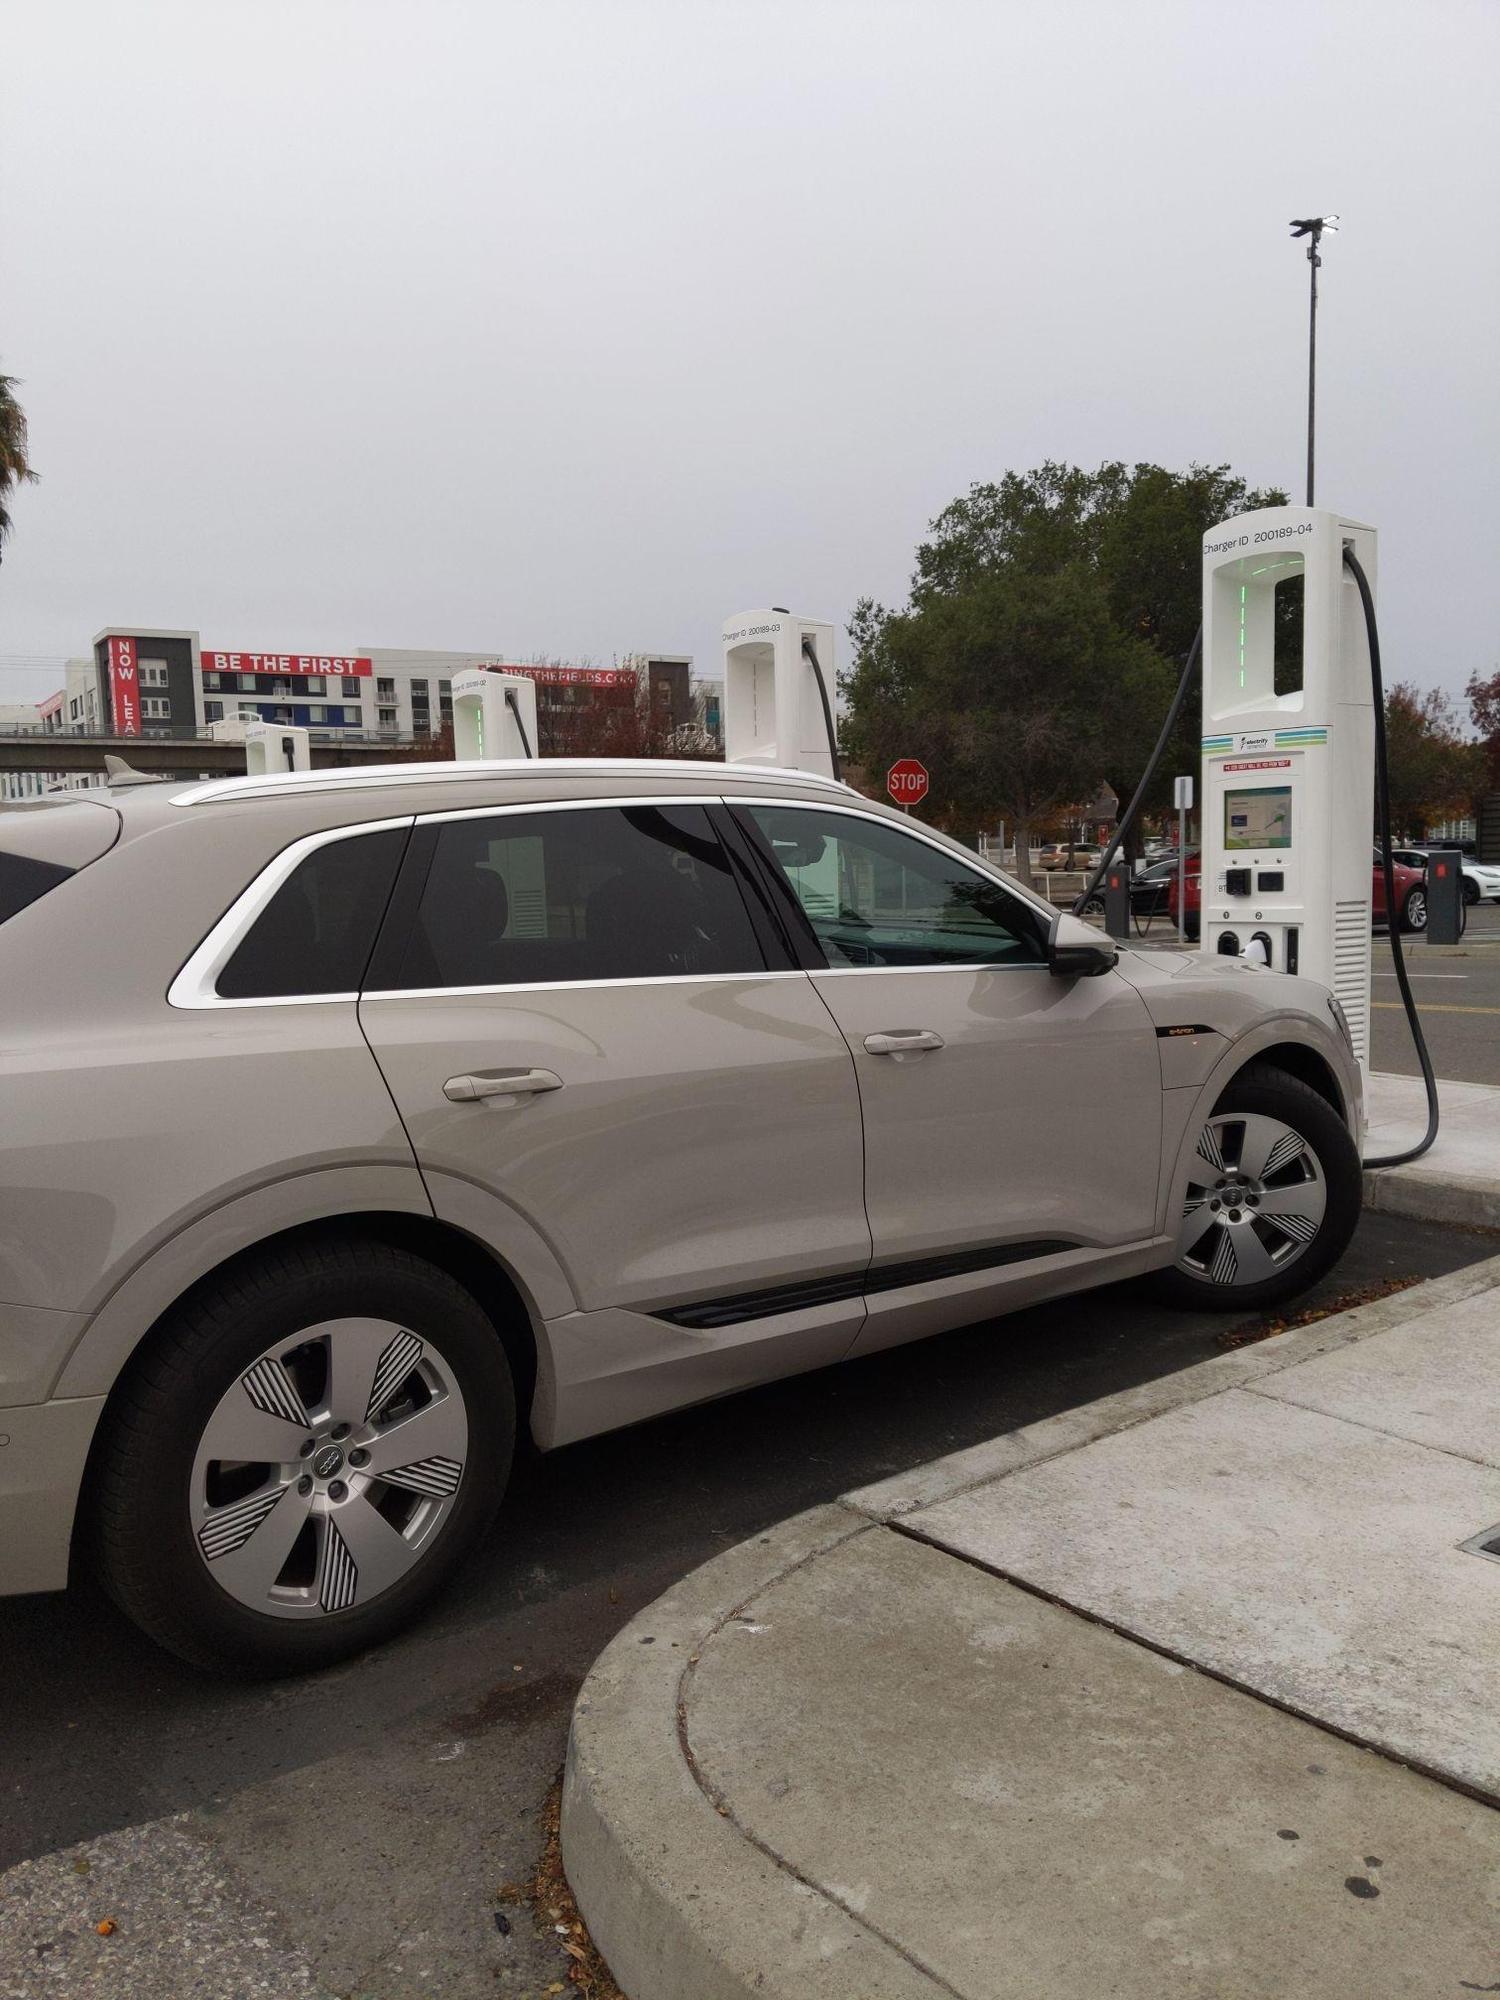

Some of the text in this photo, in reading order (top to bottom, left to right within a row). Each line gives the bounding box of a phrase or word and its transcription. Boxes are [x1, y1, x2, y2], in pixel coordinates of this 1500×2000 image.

[1239, 536, 1249, 547] ID
[1254, 523, 1313, 543] 200189-04
[214, 654, 357, 674] BE THE FIRST
[118, 641, 136, 737] NOW LEA
[890, 773, 926, 790] STOP
